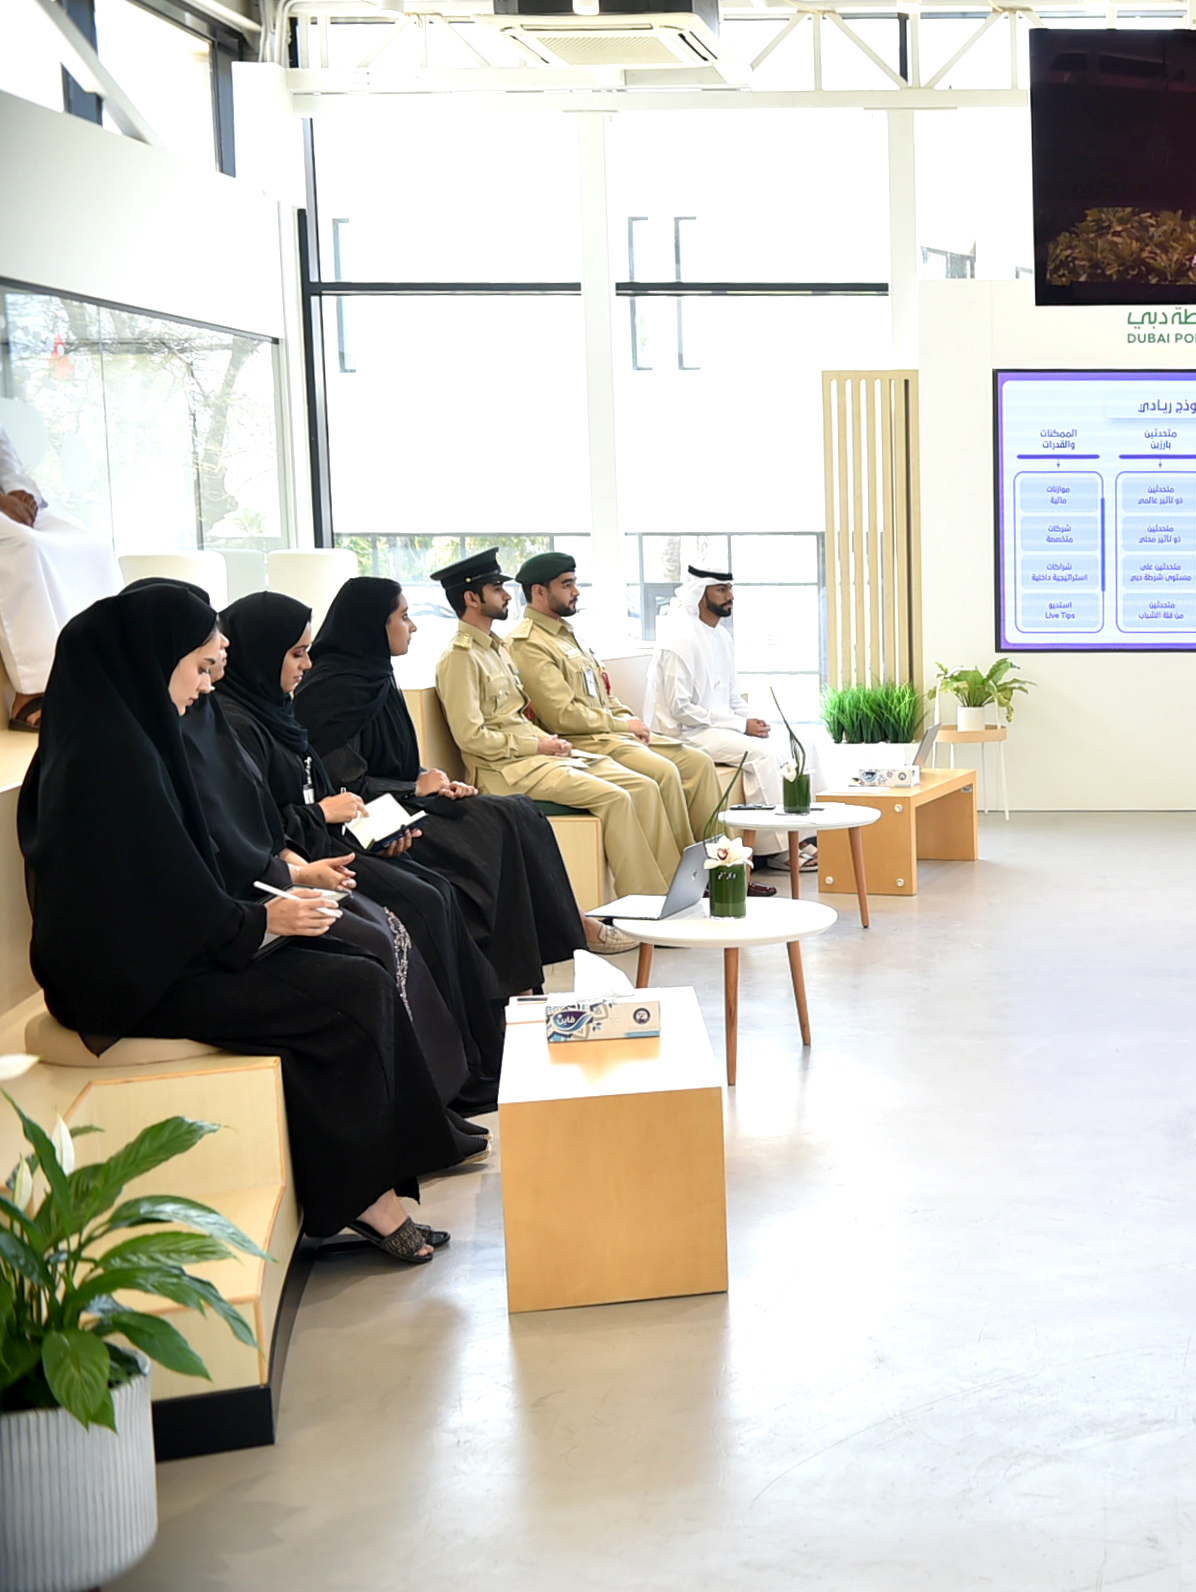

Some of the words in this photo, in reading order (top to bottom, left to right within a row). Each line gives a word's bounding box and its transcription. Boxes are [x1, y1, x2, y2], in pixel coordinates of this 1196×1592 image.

[1127, 311, 1168, 329] دبي
[1128, 333, 1170, 343] DUBAI
[1040, 429, 1077, 438] الممكنات
[1144, 429, 1177, 439] متحدثين
[1042, 440, 1075, 451] والقدرات
[1150, 441, 1171, 451] بارزين
[1061, 612, 1075, 620] Tips
